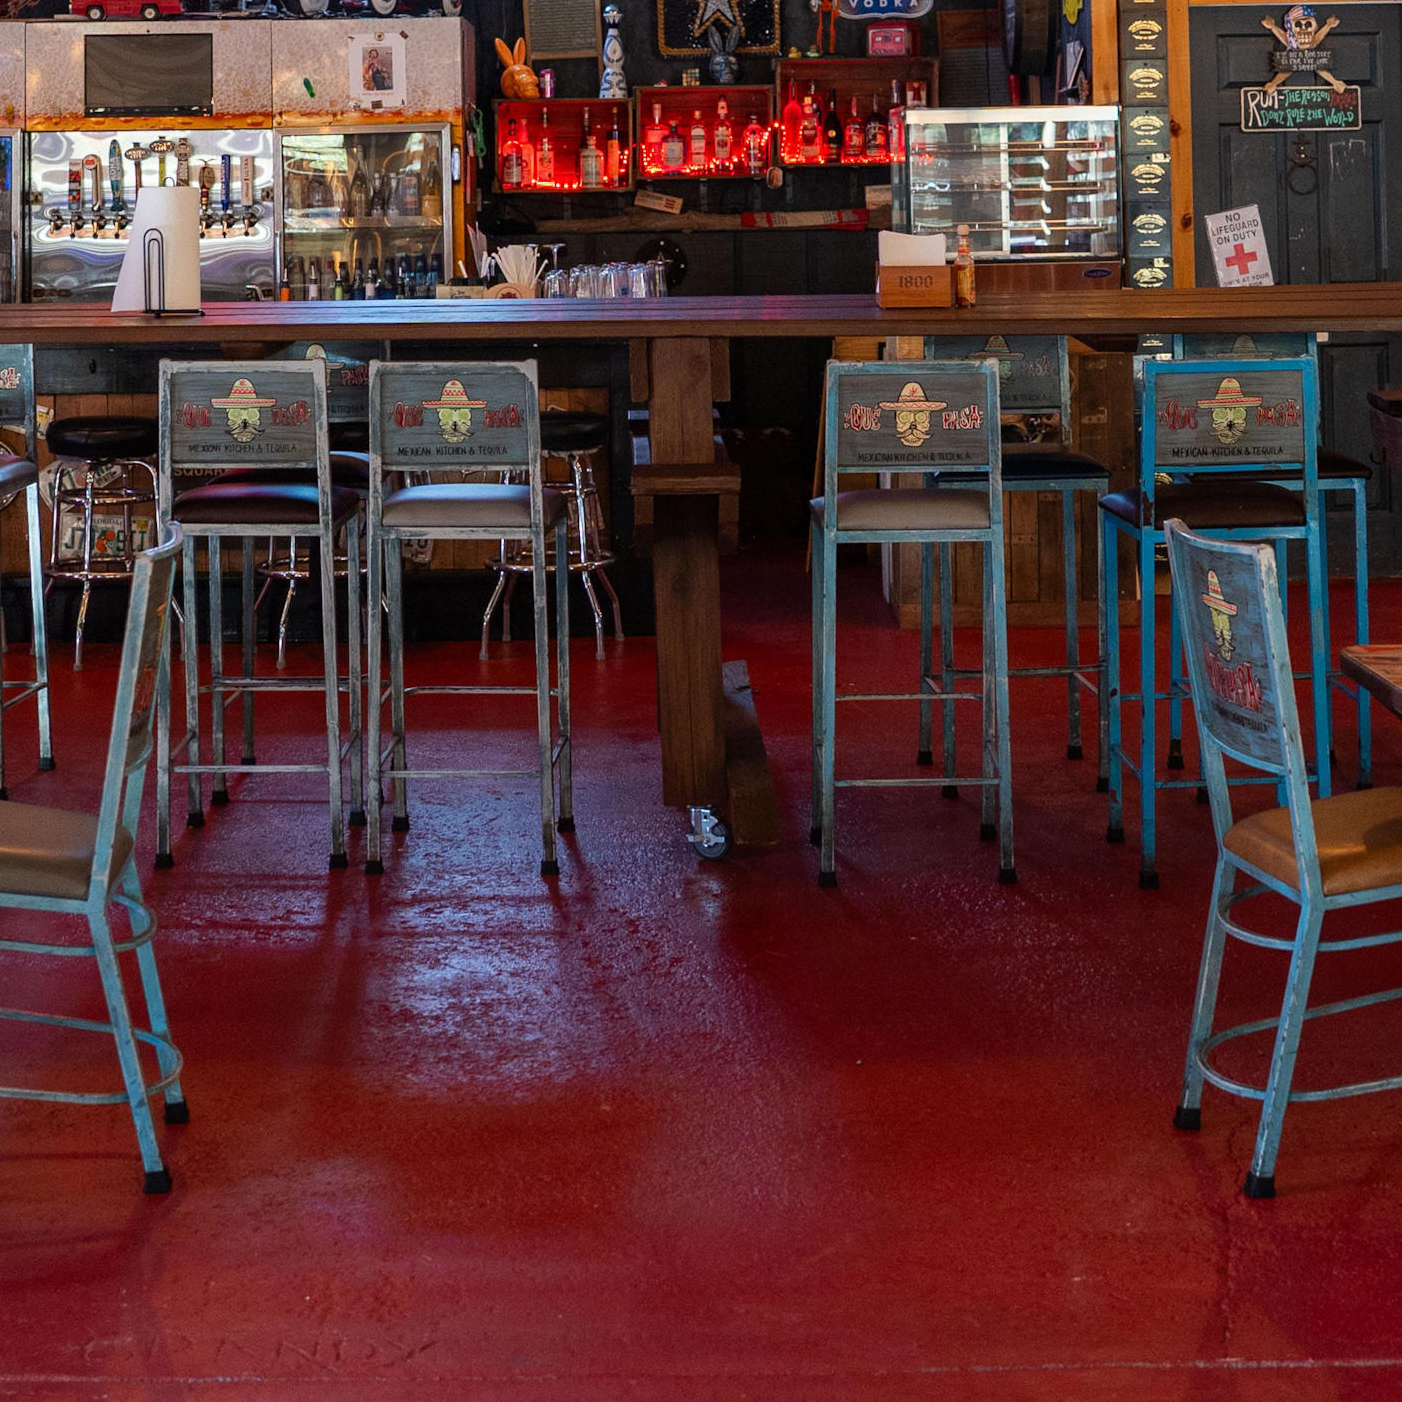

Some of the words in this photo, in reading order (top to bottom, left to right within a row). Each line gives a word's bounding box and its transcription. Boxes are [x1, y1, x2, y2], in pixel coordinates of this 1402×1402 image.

[1225, 212, 1241, 224] NO
[1211, 218, 1260, 238] LIFEGUARD
[1216, 236, 1231, 247] ON
[1232, 228, 1258, 243] DUTY
[896, 275, 933, 289] 1800
